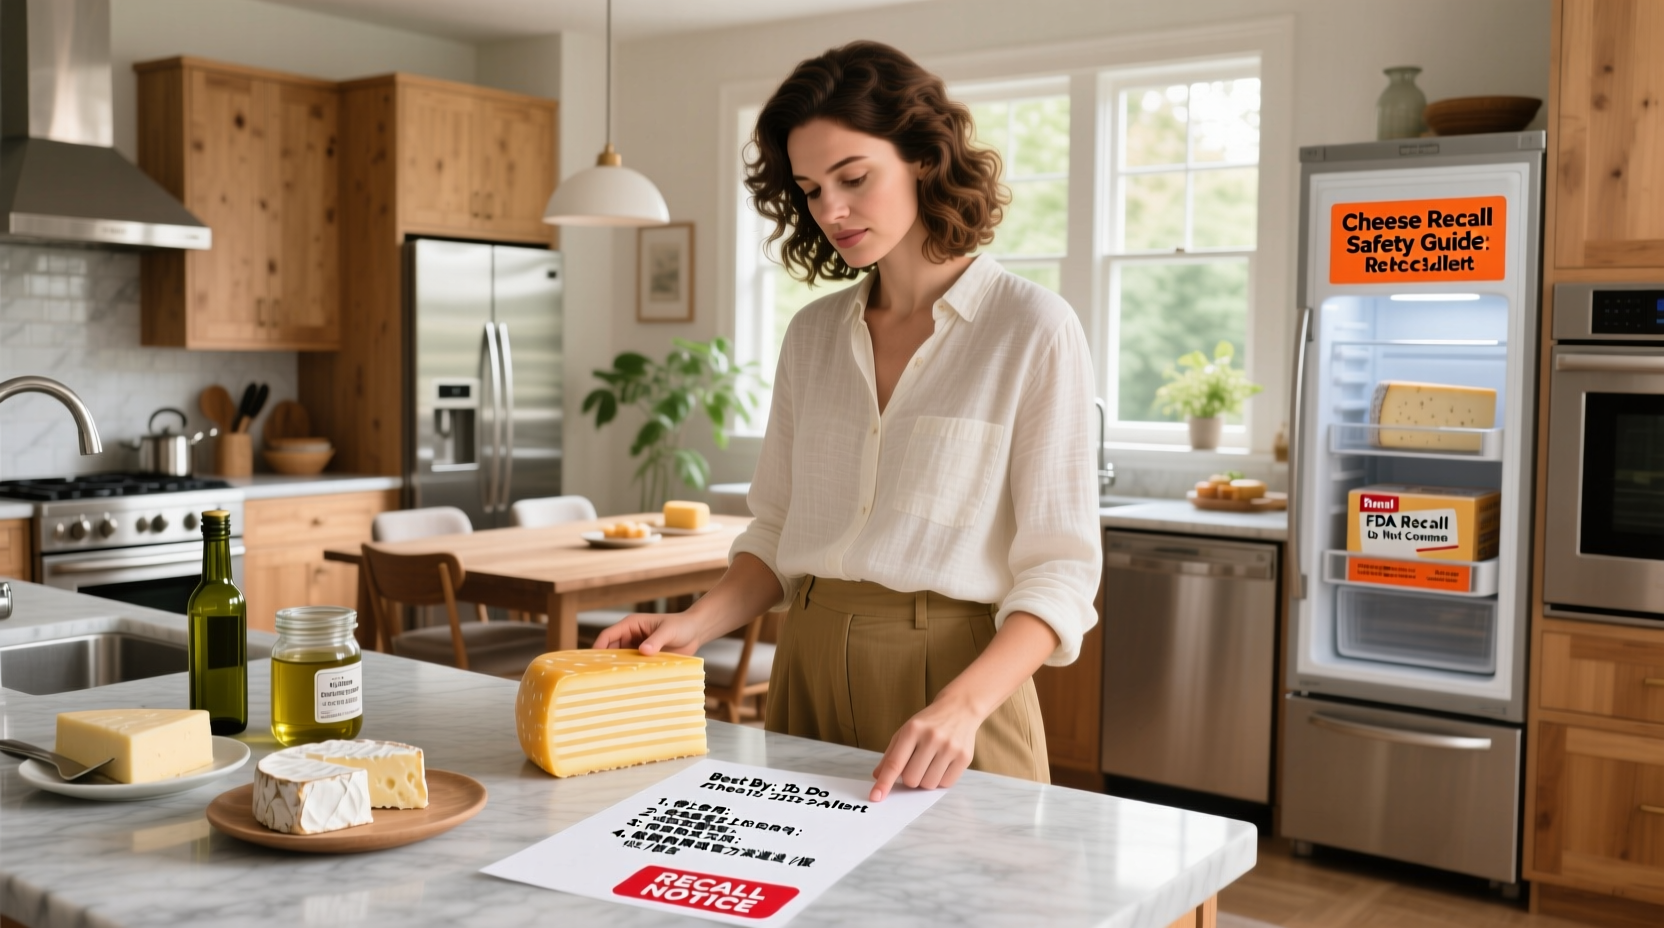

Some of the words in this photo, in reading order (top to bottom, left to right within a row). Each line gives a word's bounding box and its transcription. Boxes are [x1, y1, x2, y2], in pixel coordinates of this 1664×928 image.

[1342, 212, 1422, 232] Cheese
[1427, 206, 1493, 228] Recall
[1346, 234, 1415, 257] Safety
[1420, 231, 1490, 252] Guide:
[1366, 514, 1397, 528] FDA
[1401, 515, 1449, 530] Recall
[804, 786, 830, 798] Do
[640, 883, 758, 914] NOTICE
[654, 872, 766, 901] RECALL
